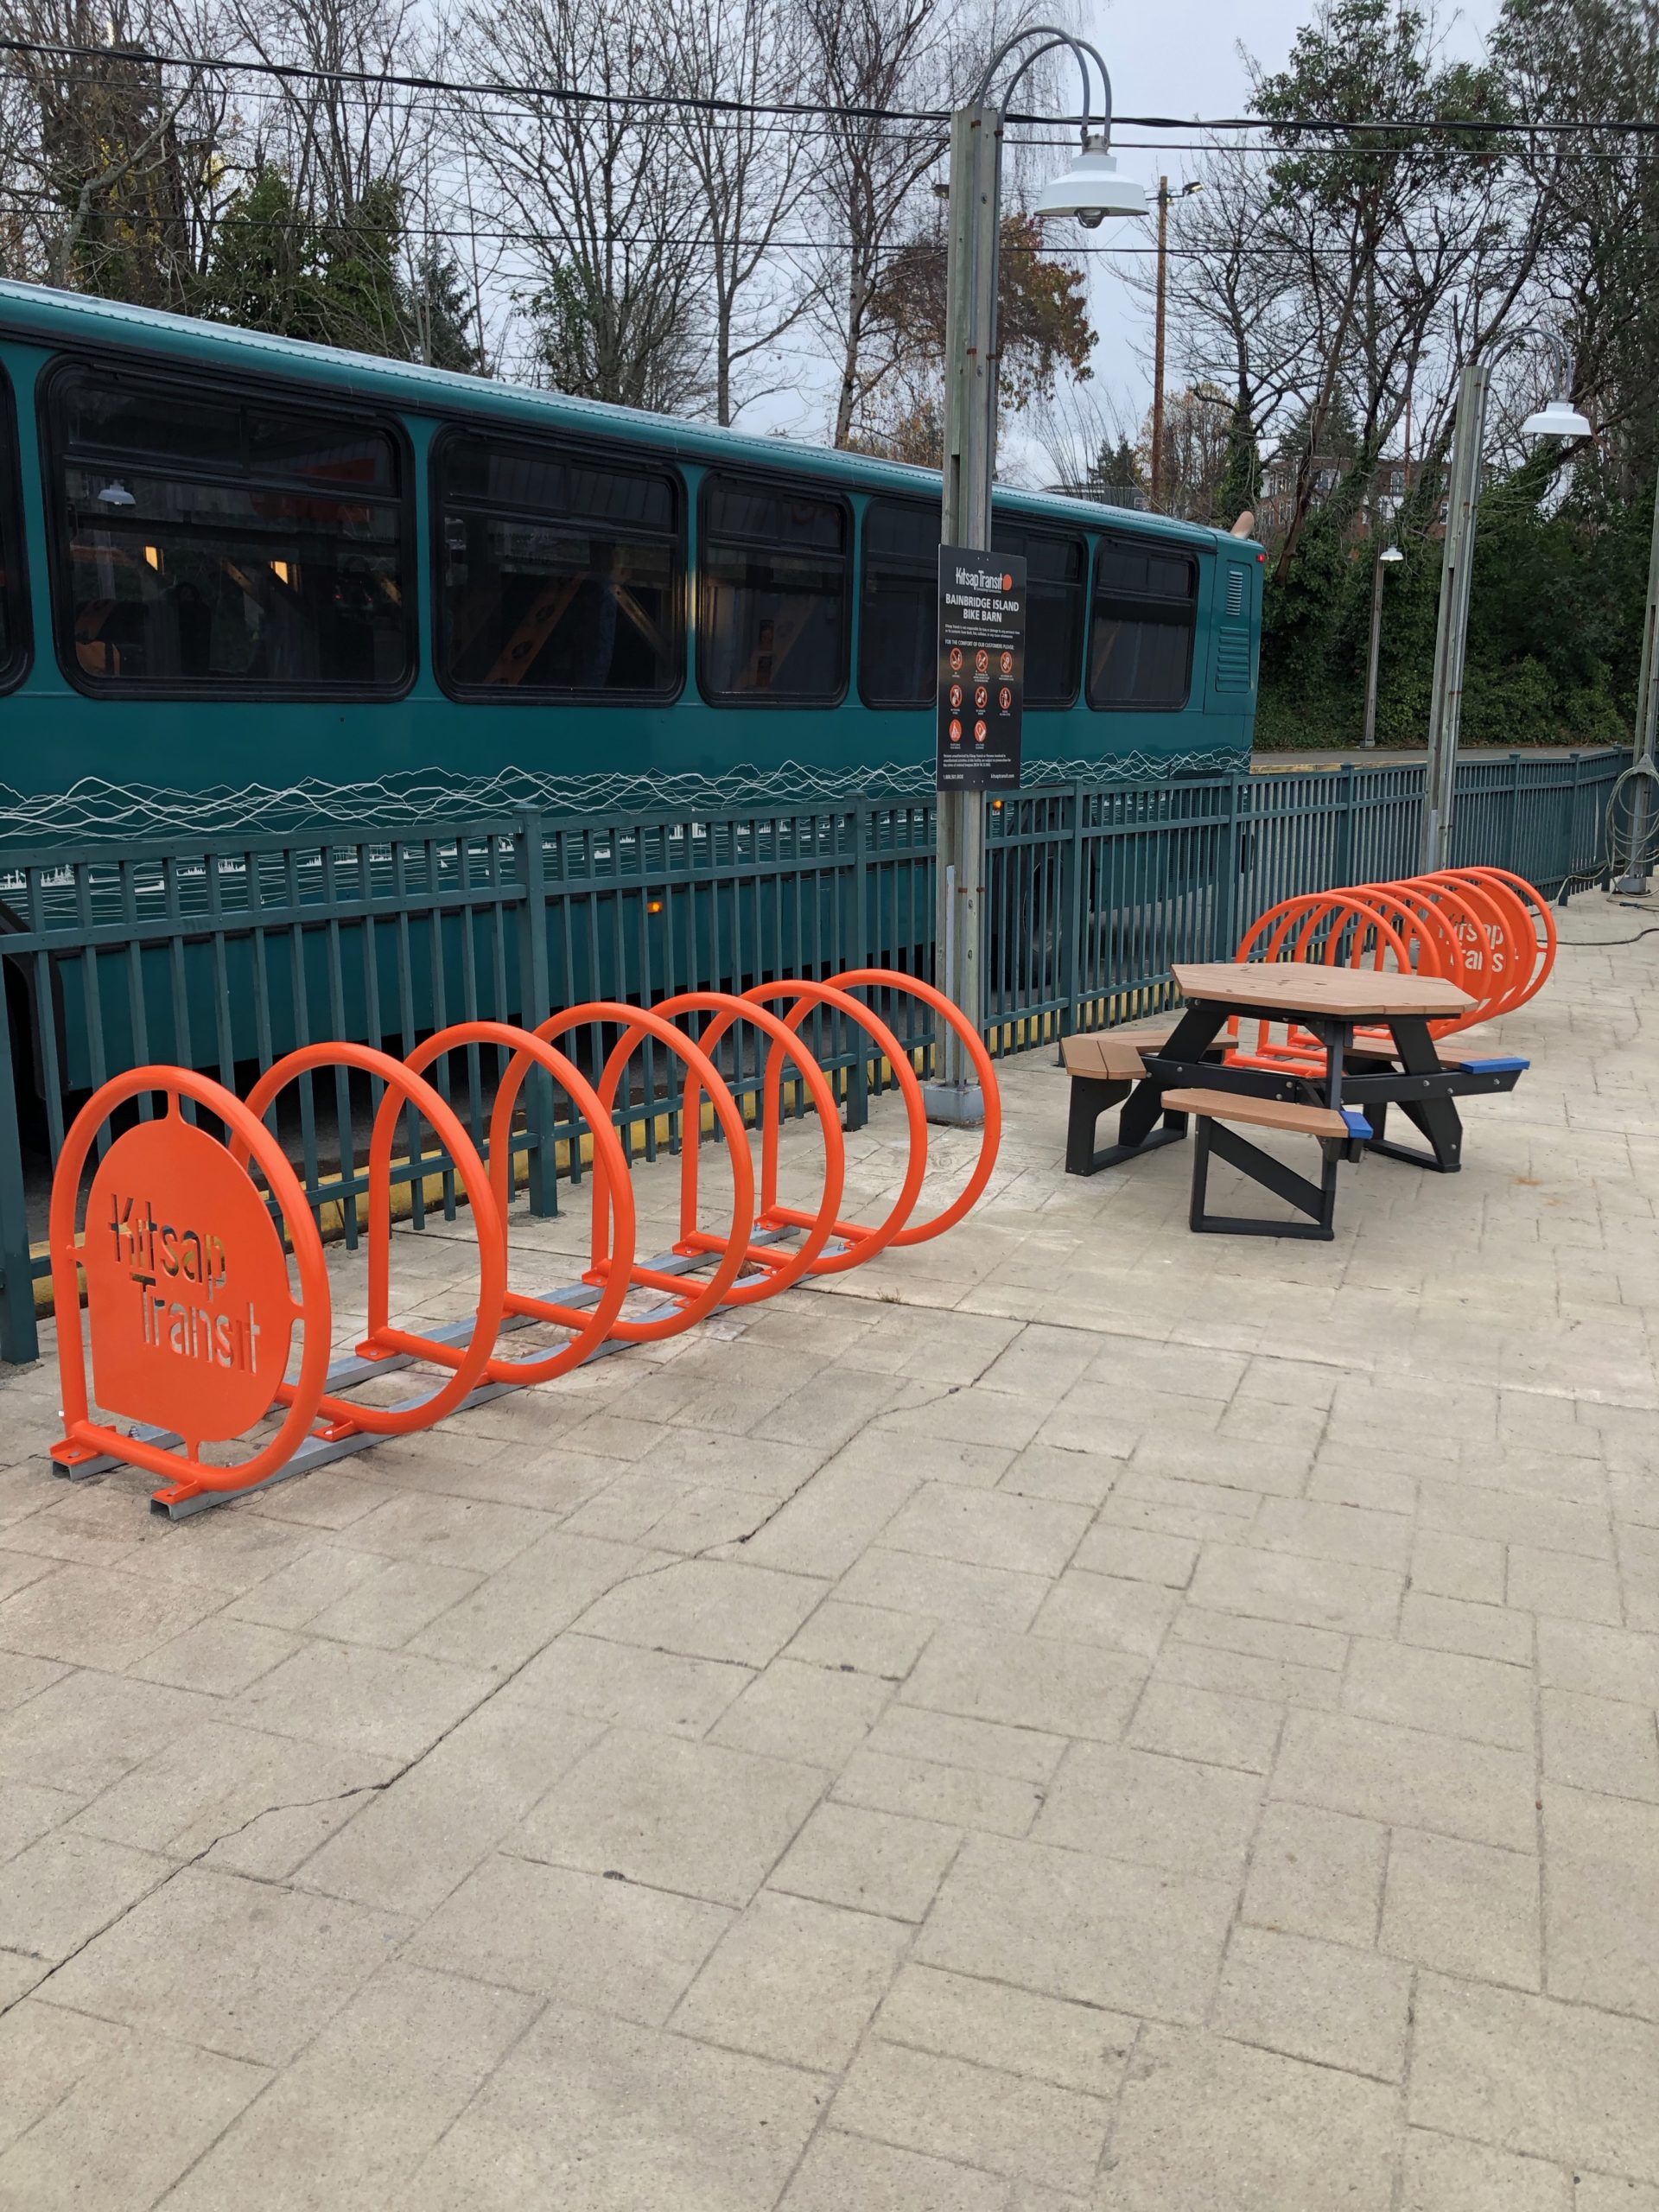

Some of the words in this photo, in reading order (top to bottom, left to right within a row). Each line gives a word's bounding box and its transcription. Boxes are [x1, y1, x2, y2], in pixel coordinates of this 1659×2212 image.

[956, 567, 978, 590] Kitsap
[978, 569, 1002, 589] Transit
[945, 594, 991, 608] BAINBRIDGE
[993, 599, 1019, 611] ISLAND
[963, 608, 980, 620] BIKE
[982, 611, 1001, 622] BARN
[109, 1193, 226, 1302] Kitsap
[130, 1272, 261, 1374] Transit
